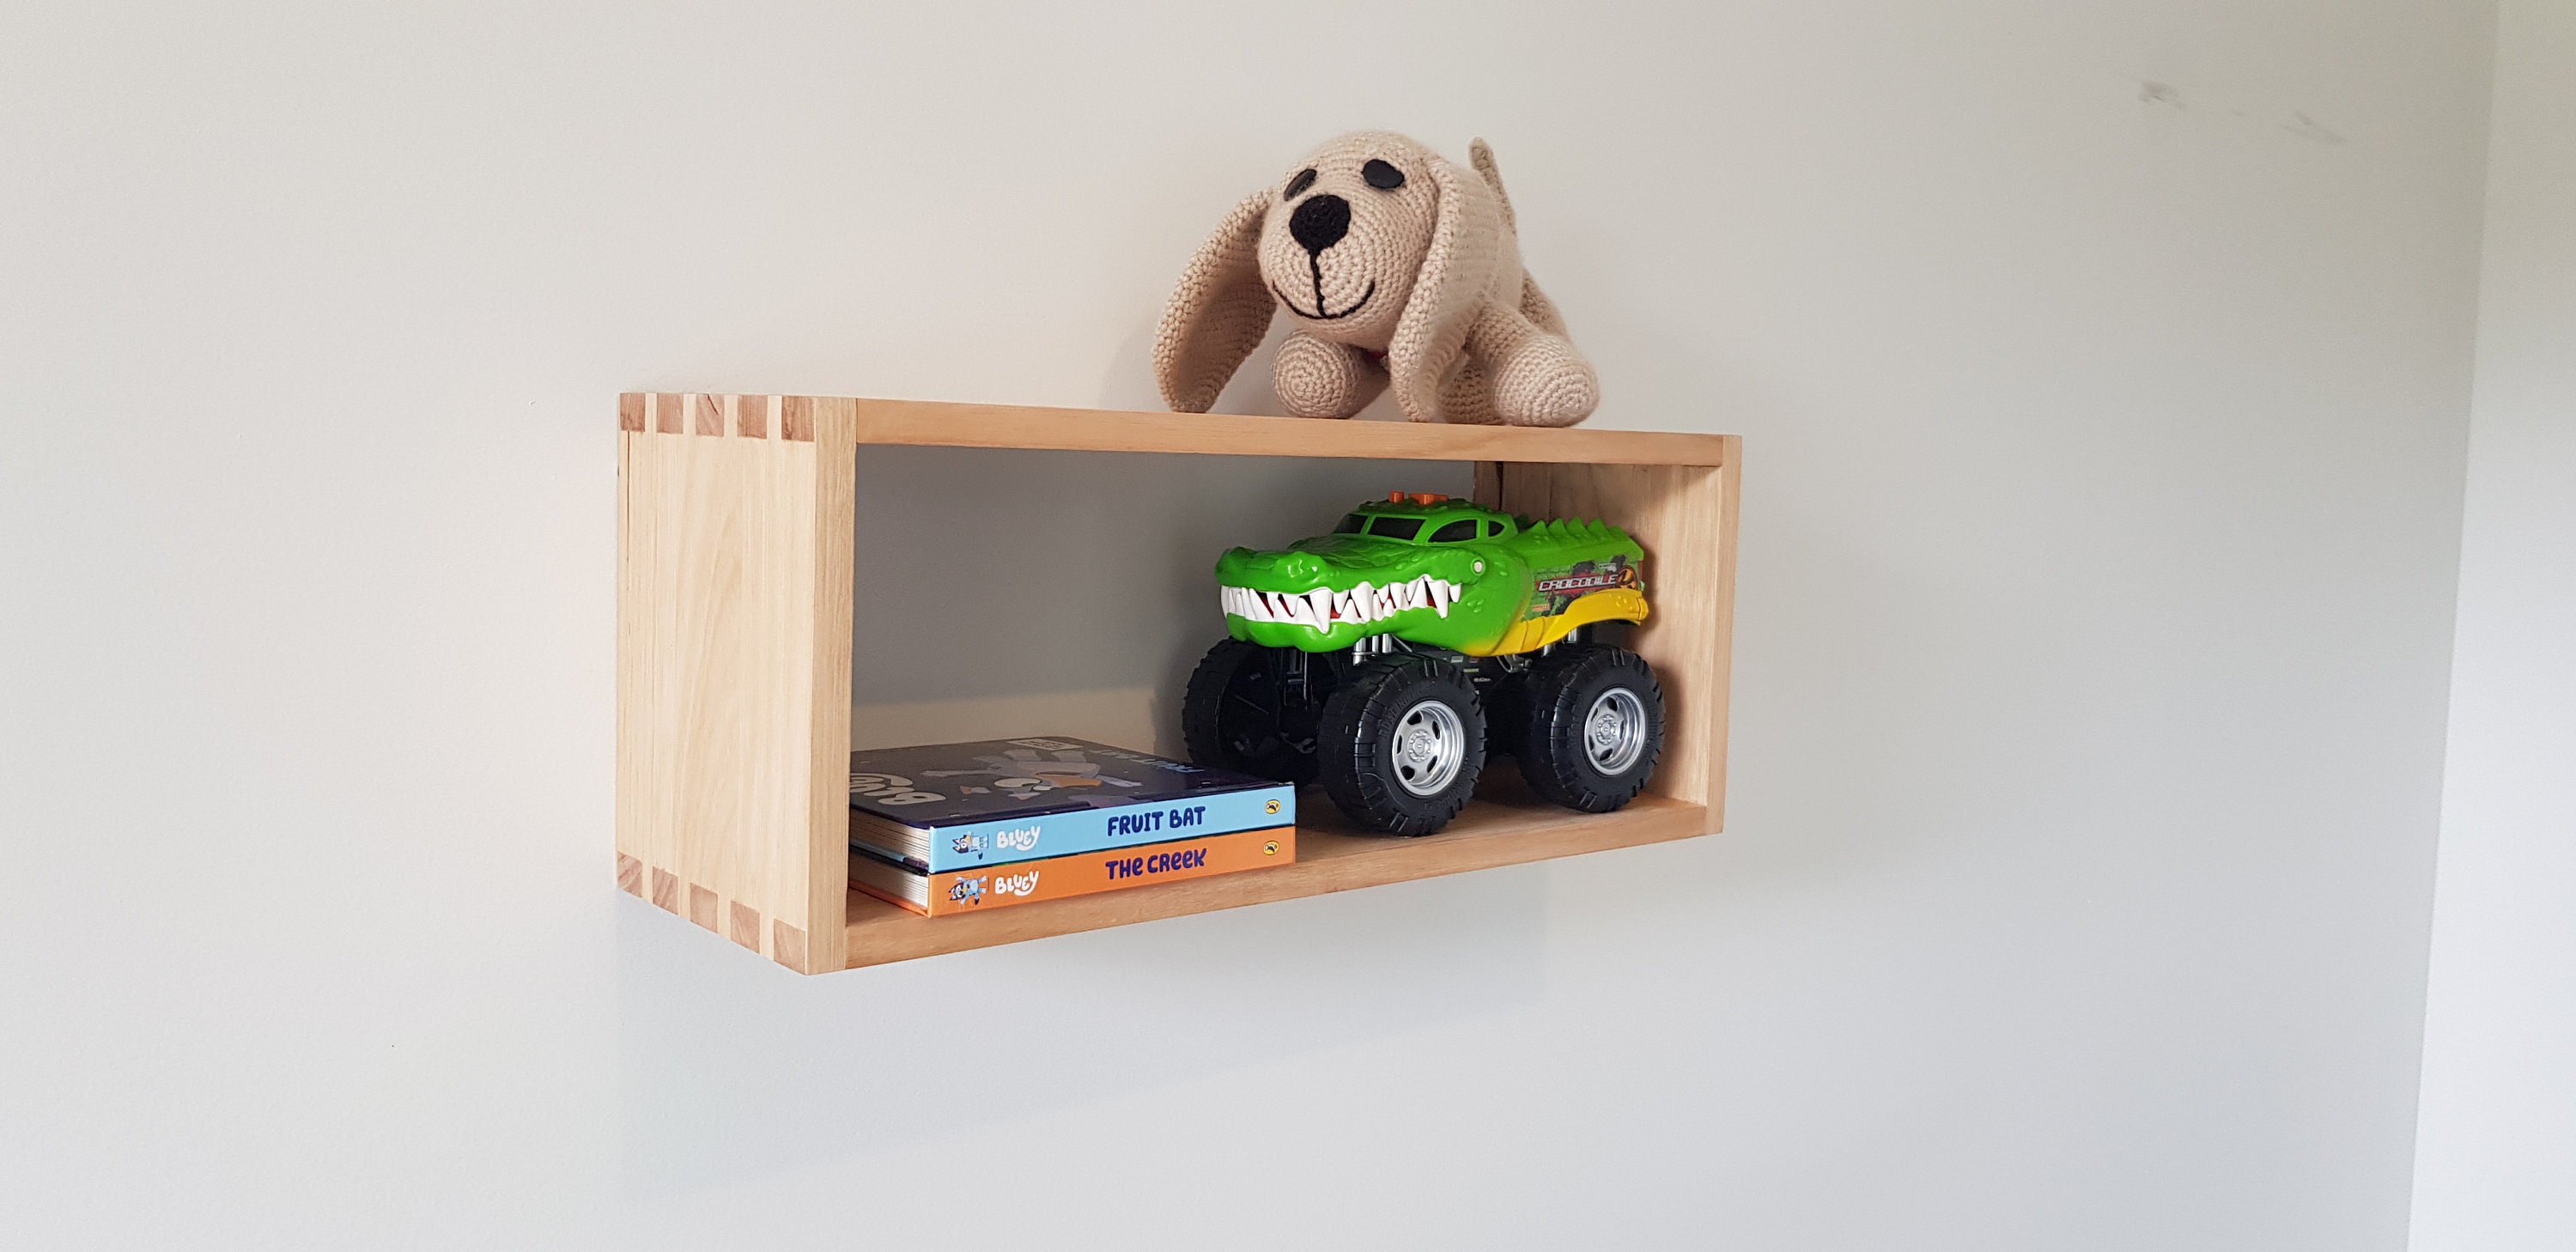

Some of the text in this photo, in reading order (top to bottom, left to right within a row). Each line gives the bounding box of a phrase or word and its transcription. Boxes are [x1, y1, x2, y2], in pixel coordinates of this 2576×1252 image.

[1539, 574, 1618, 592] CROCODILE
[1108, 805, 1206, 837] FRUIT BAT
[997, 825, 1041, 851] BLUEY
[994, 870, 1040, 896] BLUEY
